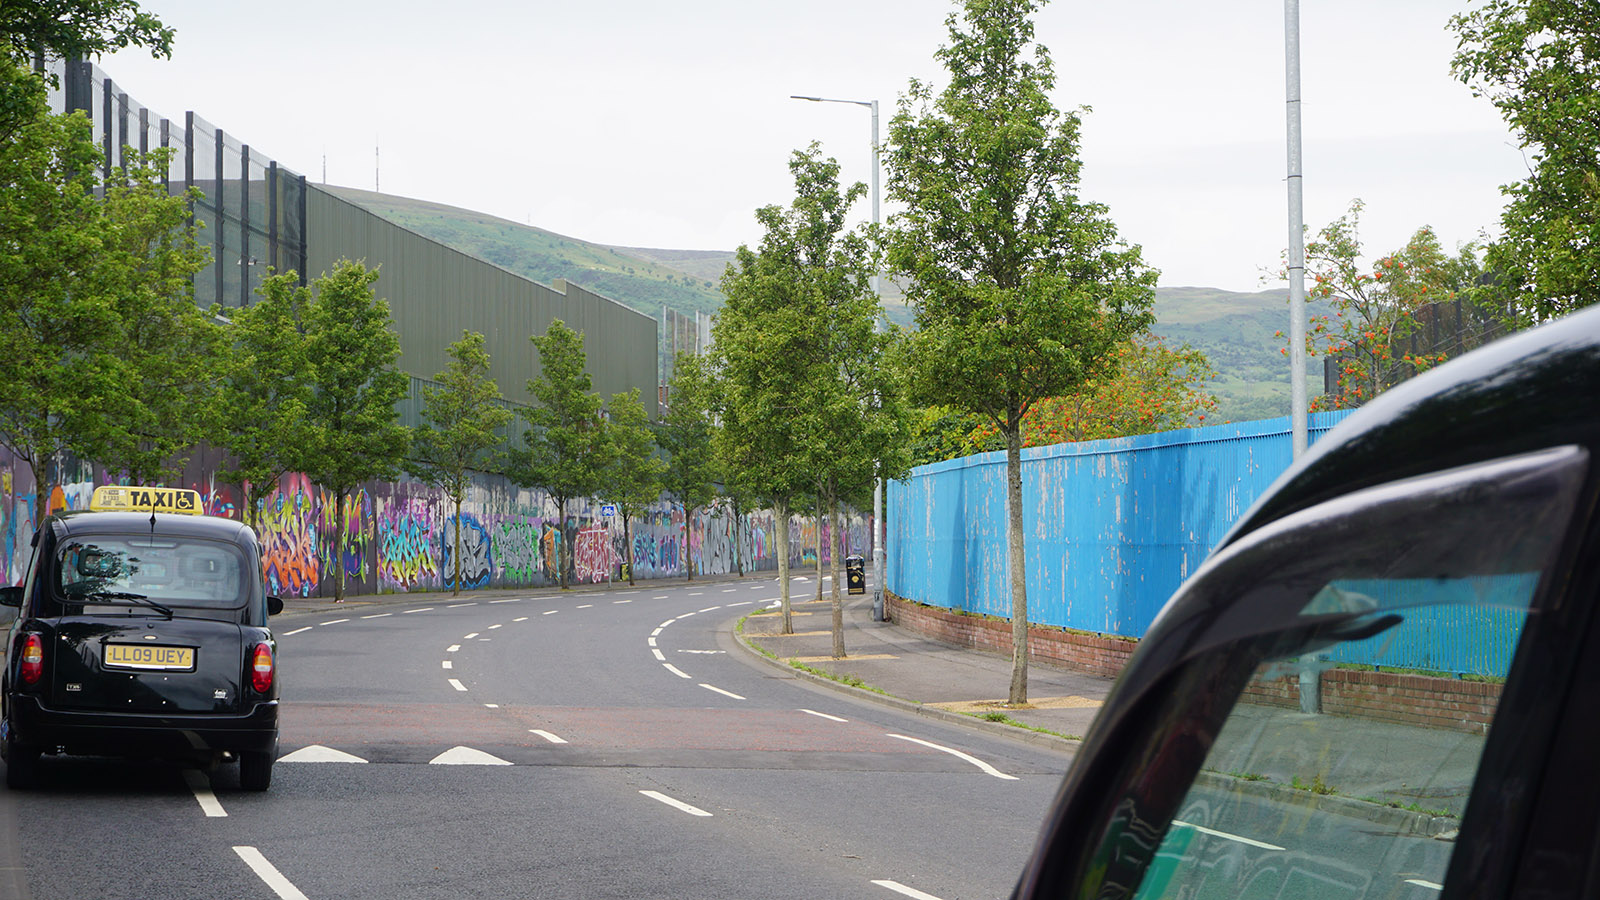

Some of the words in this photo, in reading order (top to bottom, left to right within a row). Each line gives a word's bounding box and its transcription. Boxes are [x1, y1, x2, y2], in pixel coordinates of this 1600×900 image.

[130, 491, 173, 507] TAXI
[112, 648, 152, 662] LL09
[156, 649, 186, 663] UEY
